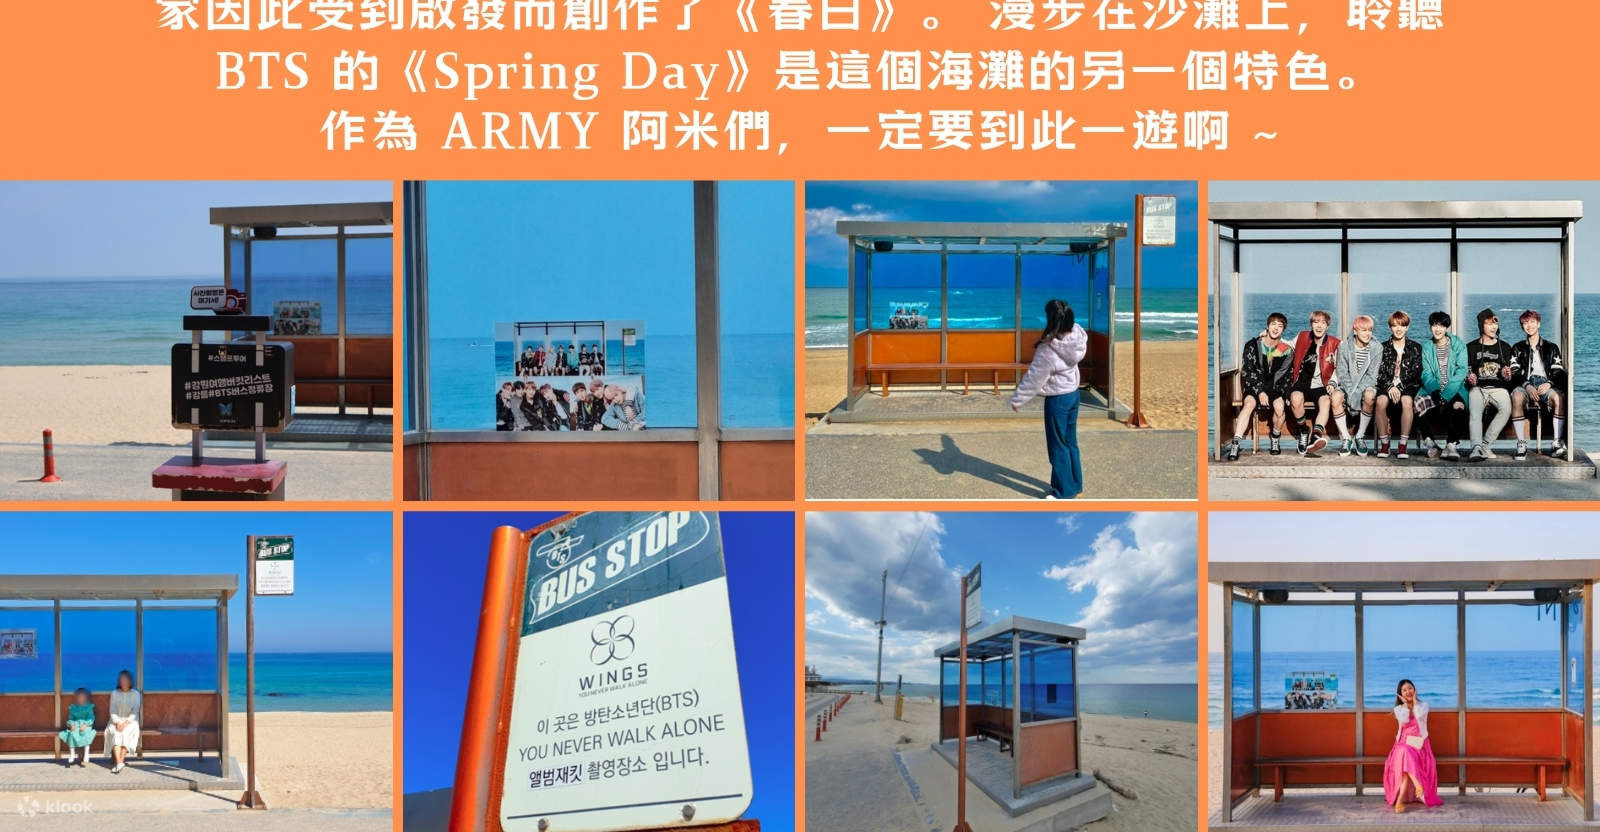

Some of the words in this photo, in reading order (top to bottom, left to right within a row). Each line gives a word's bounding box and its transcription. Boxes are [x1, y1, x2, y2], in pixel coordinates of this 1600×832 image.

[537, 555, 597, 616] BUS
[605, 511, 691, 579] STOP
[579, 663, 648, 691] WINGS
[537, 718, 550, 735] 이
[553, 713, 580, 733] 곳은
[584, 688, 700, 727] 방탄소년단(BTS)
[519, 743, 548, 762] YOU
[553, 735, 603, 756] NEVER
[608, 725, 656, 747] WALK
[661, 714, 726, 739] ALONE
[529, 764, 583, 789] 앨범재킷
[587, 755, 647, 780] 촬영장소
[653, 746, 710, 771] 입니다.
